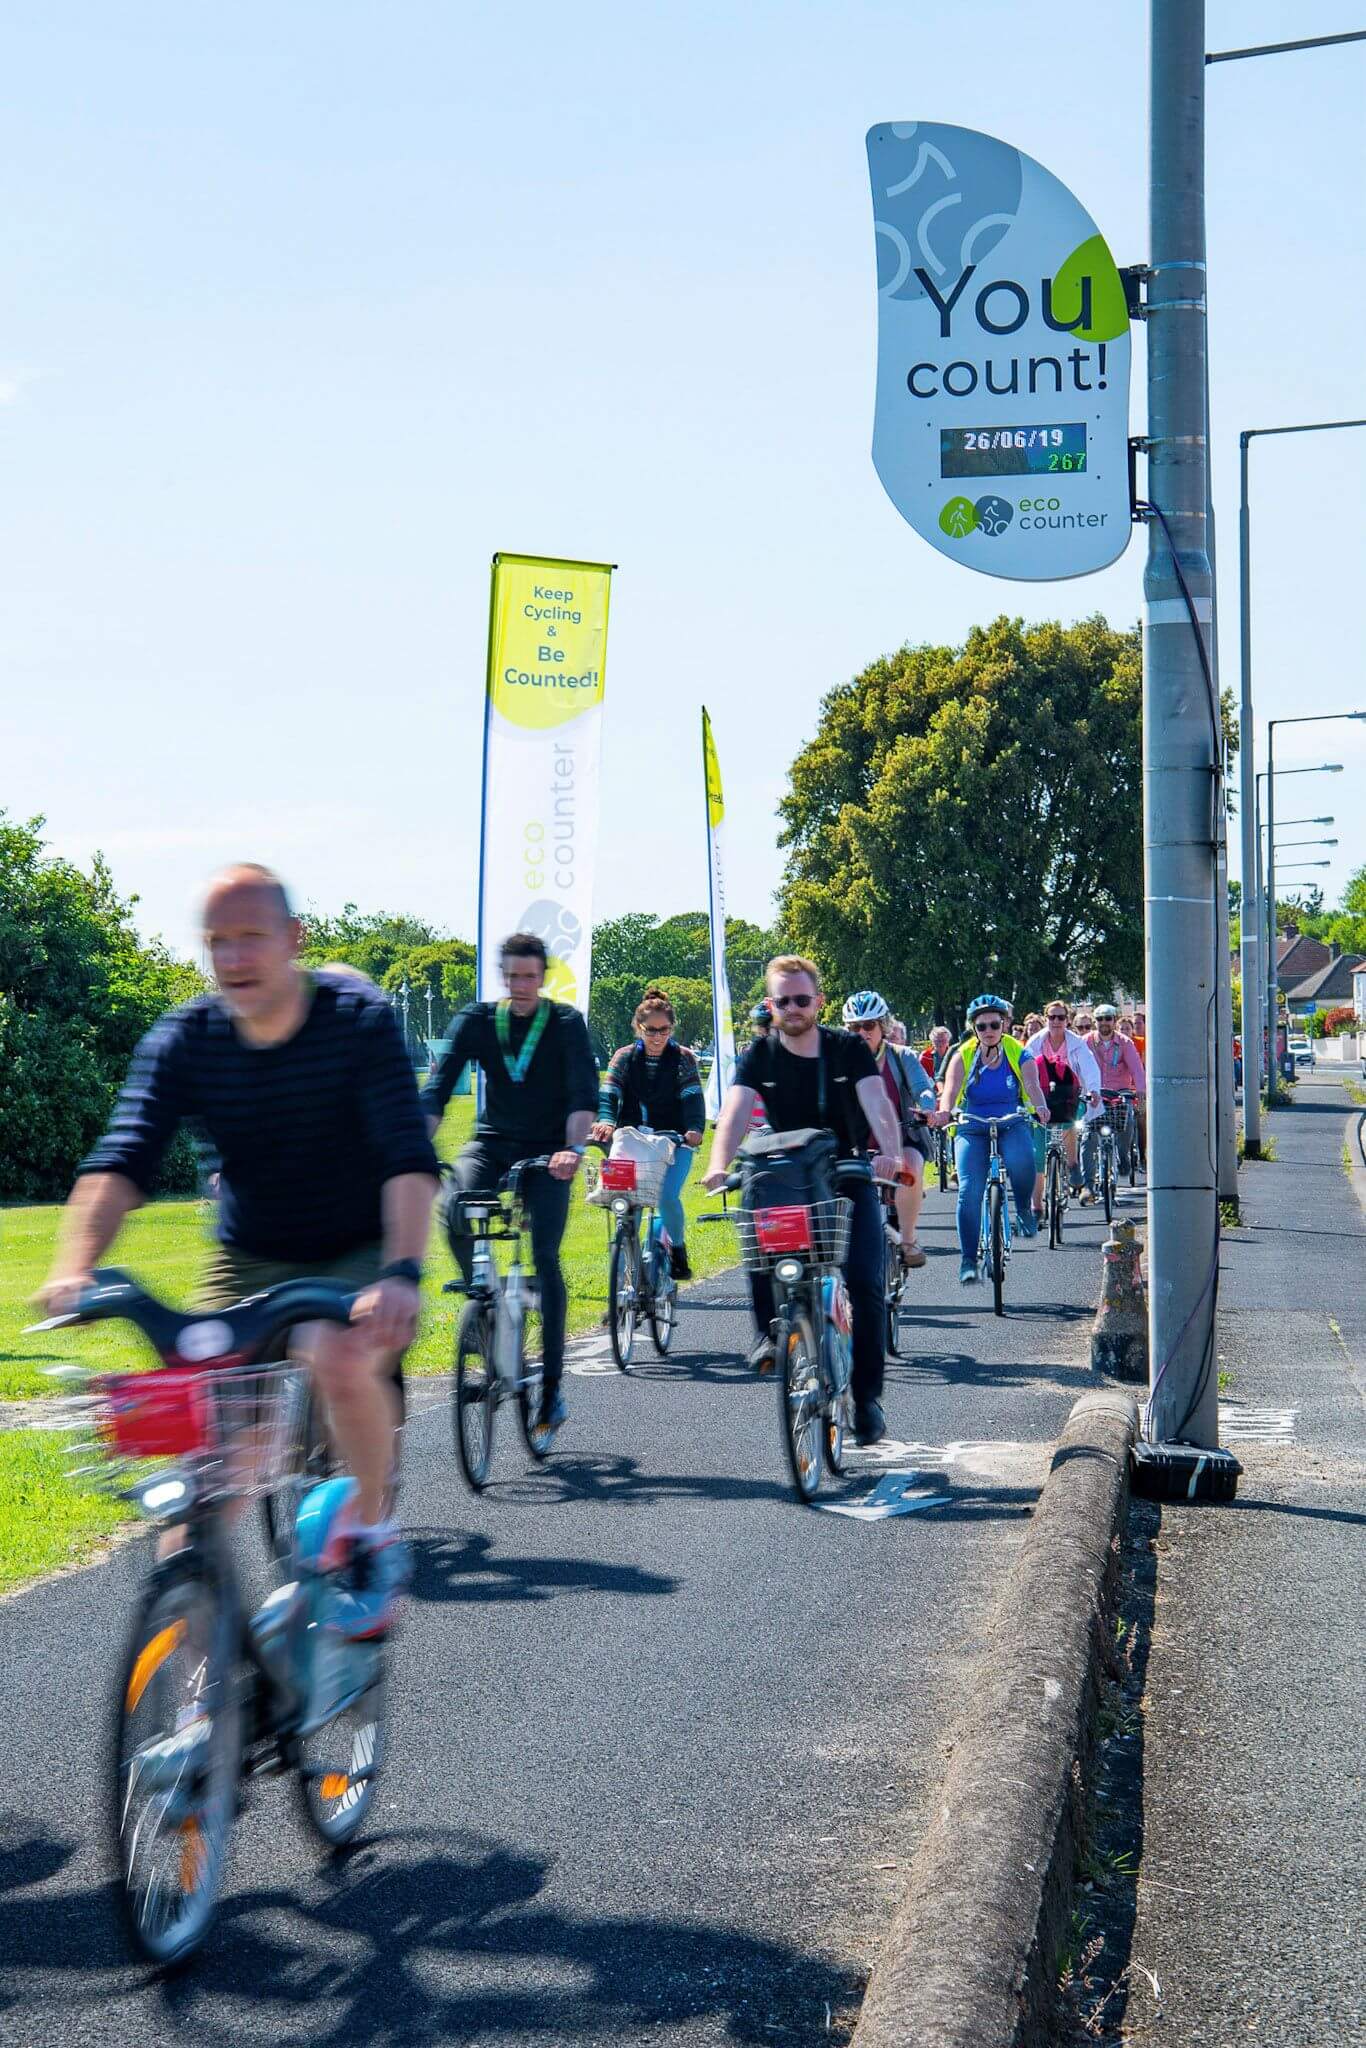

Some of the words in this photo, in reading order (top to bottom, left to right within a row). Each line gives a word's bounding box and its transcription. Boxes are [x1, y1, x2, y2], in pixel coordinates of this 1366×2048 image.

[913, 264, 1092, 338] You
[907, 343, 1108, 398] count!
[964, 429, 1064, 450] 26/06/19
[1048, 452, 1086, 471] 267
[1018, 497, 1060, 512] eco
[1019, 512, 1108, 530] counter
[533, 585, 574, 603] Keep
[524, 604, 582, 624] Cycling
[546, 625, 557, 637] &
[537, 645, 565, 662] Be
[504, 667, 599, 688] Counted!
[550, 743, 575, 889] counter
[523, 821, 545, 890] eco
